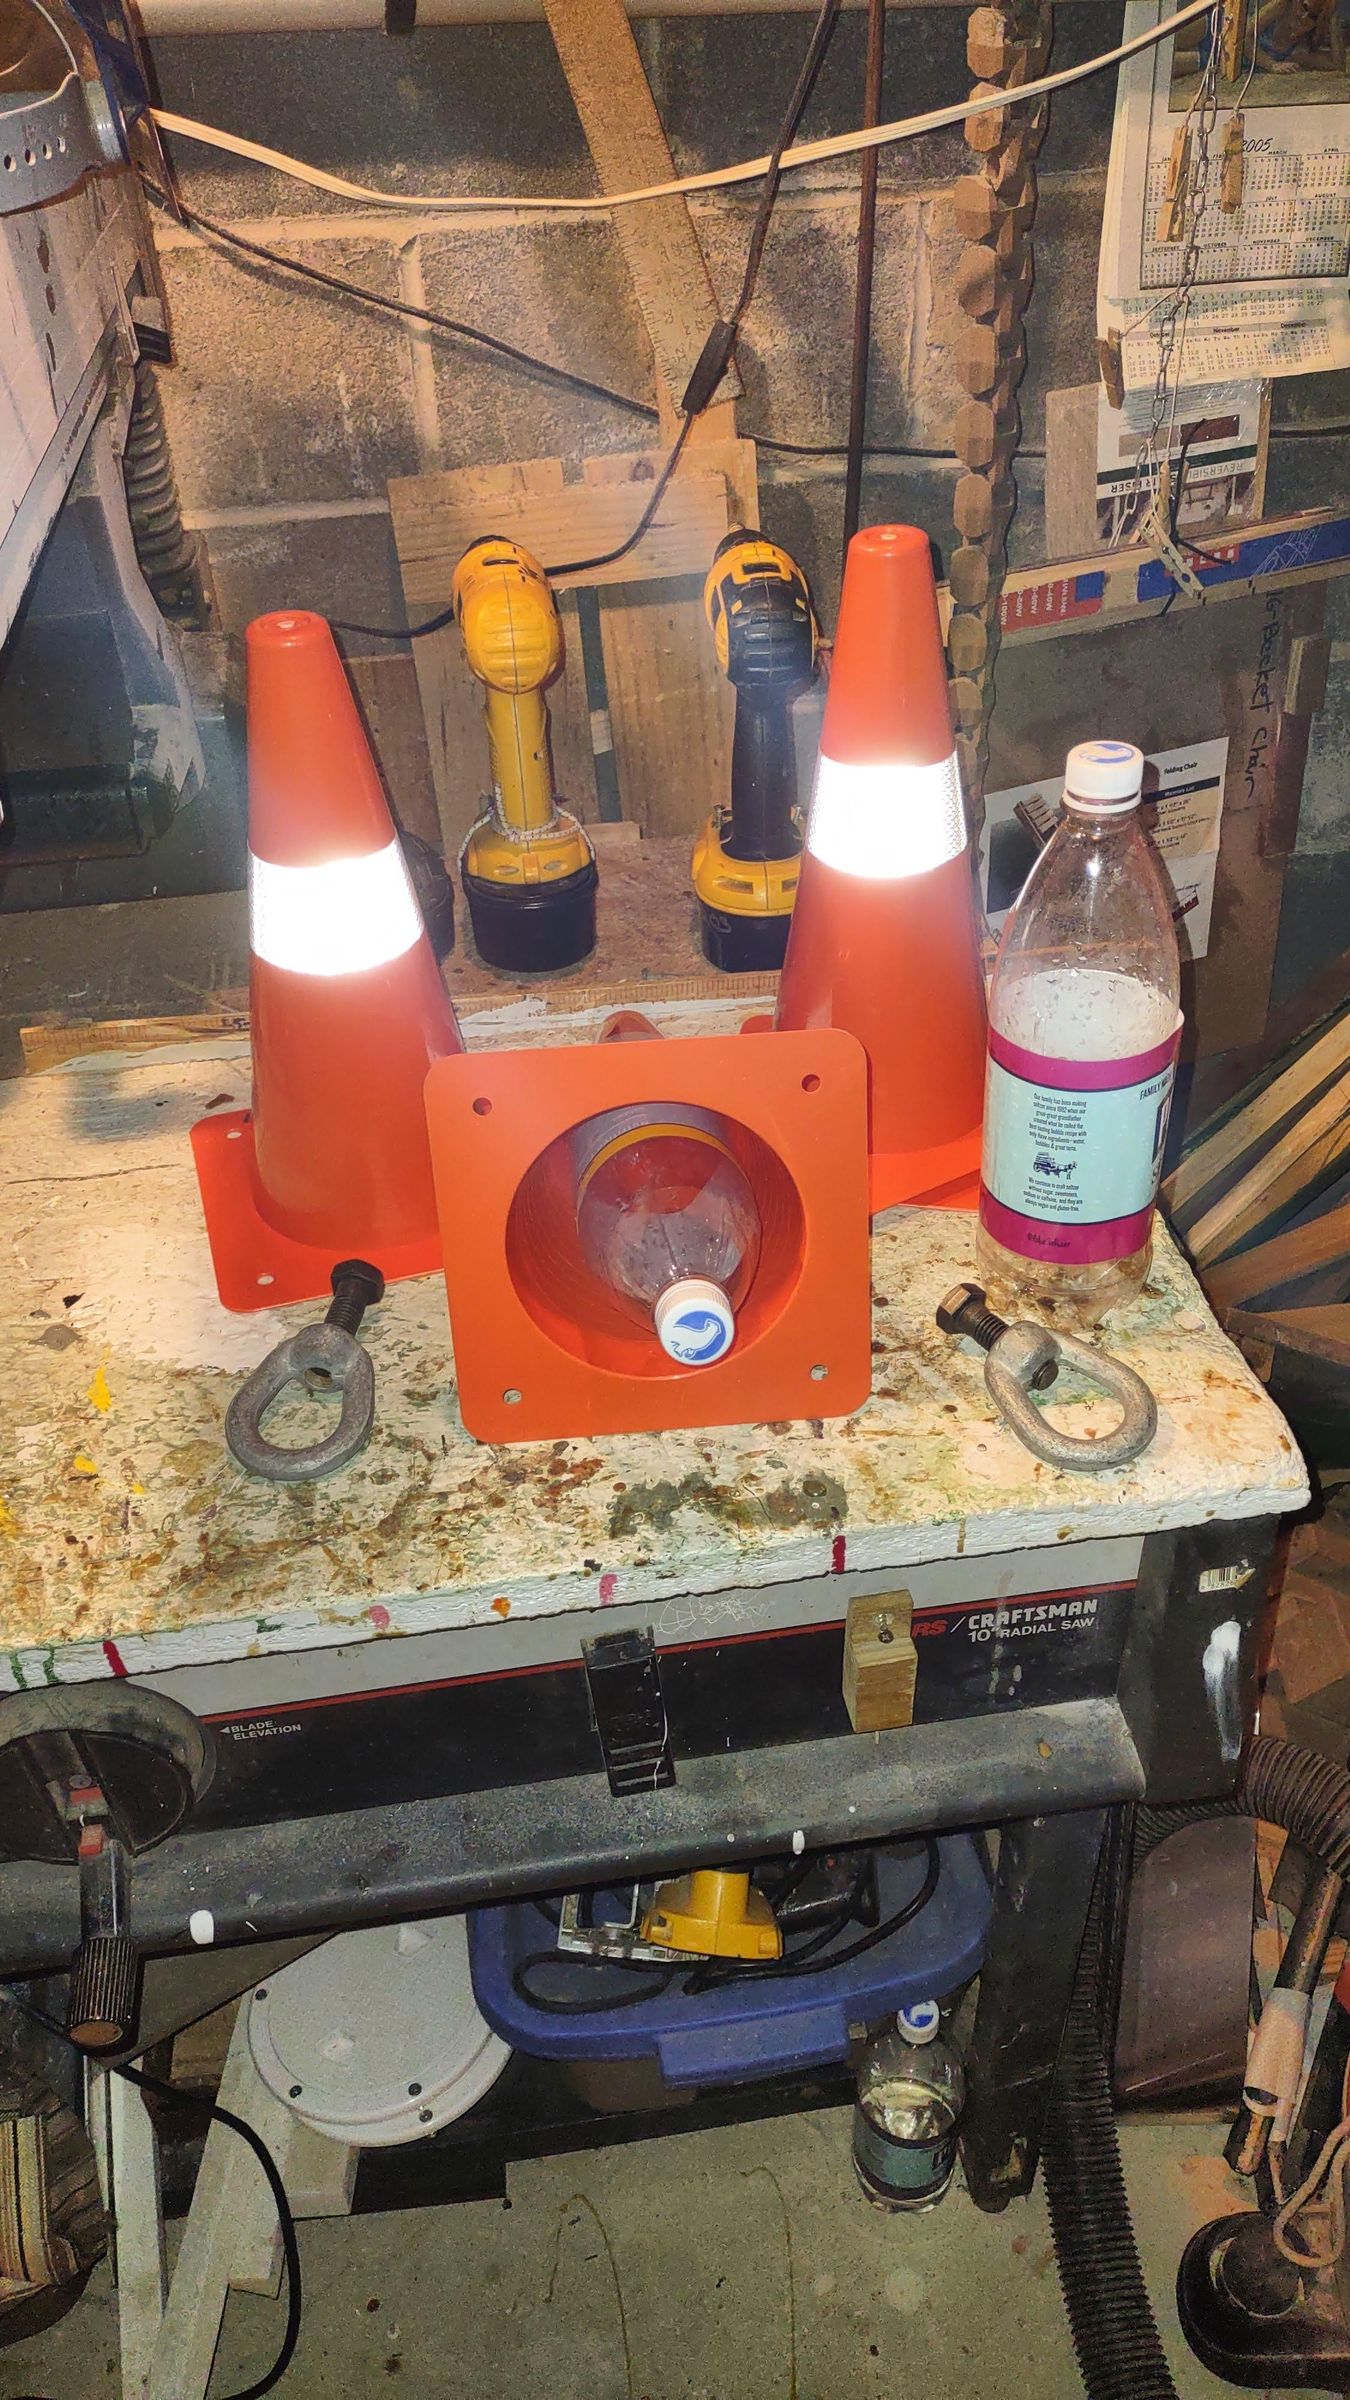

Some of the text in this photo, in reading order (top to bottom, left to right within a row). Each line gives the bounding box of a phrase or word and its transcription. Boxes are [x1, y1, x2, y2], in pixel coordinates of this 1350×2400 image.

[1245, 727, 1268, 798] Chair
[1041, 1096, 1052, 1104] family
[1140, 1084, 1160, 1100] FAMILY
[968, 1600, 1098, 1630] CRAFTSMAN
[999, 1622, 1056, 1639] RADIAL
[1061, 1617, 1095, 1630] SAW
[230, 1720, 273, 1733] BLADE
[233, 1724, 302, 1740] ELEVATION
